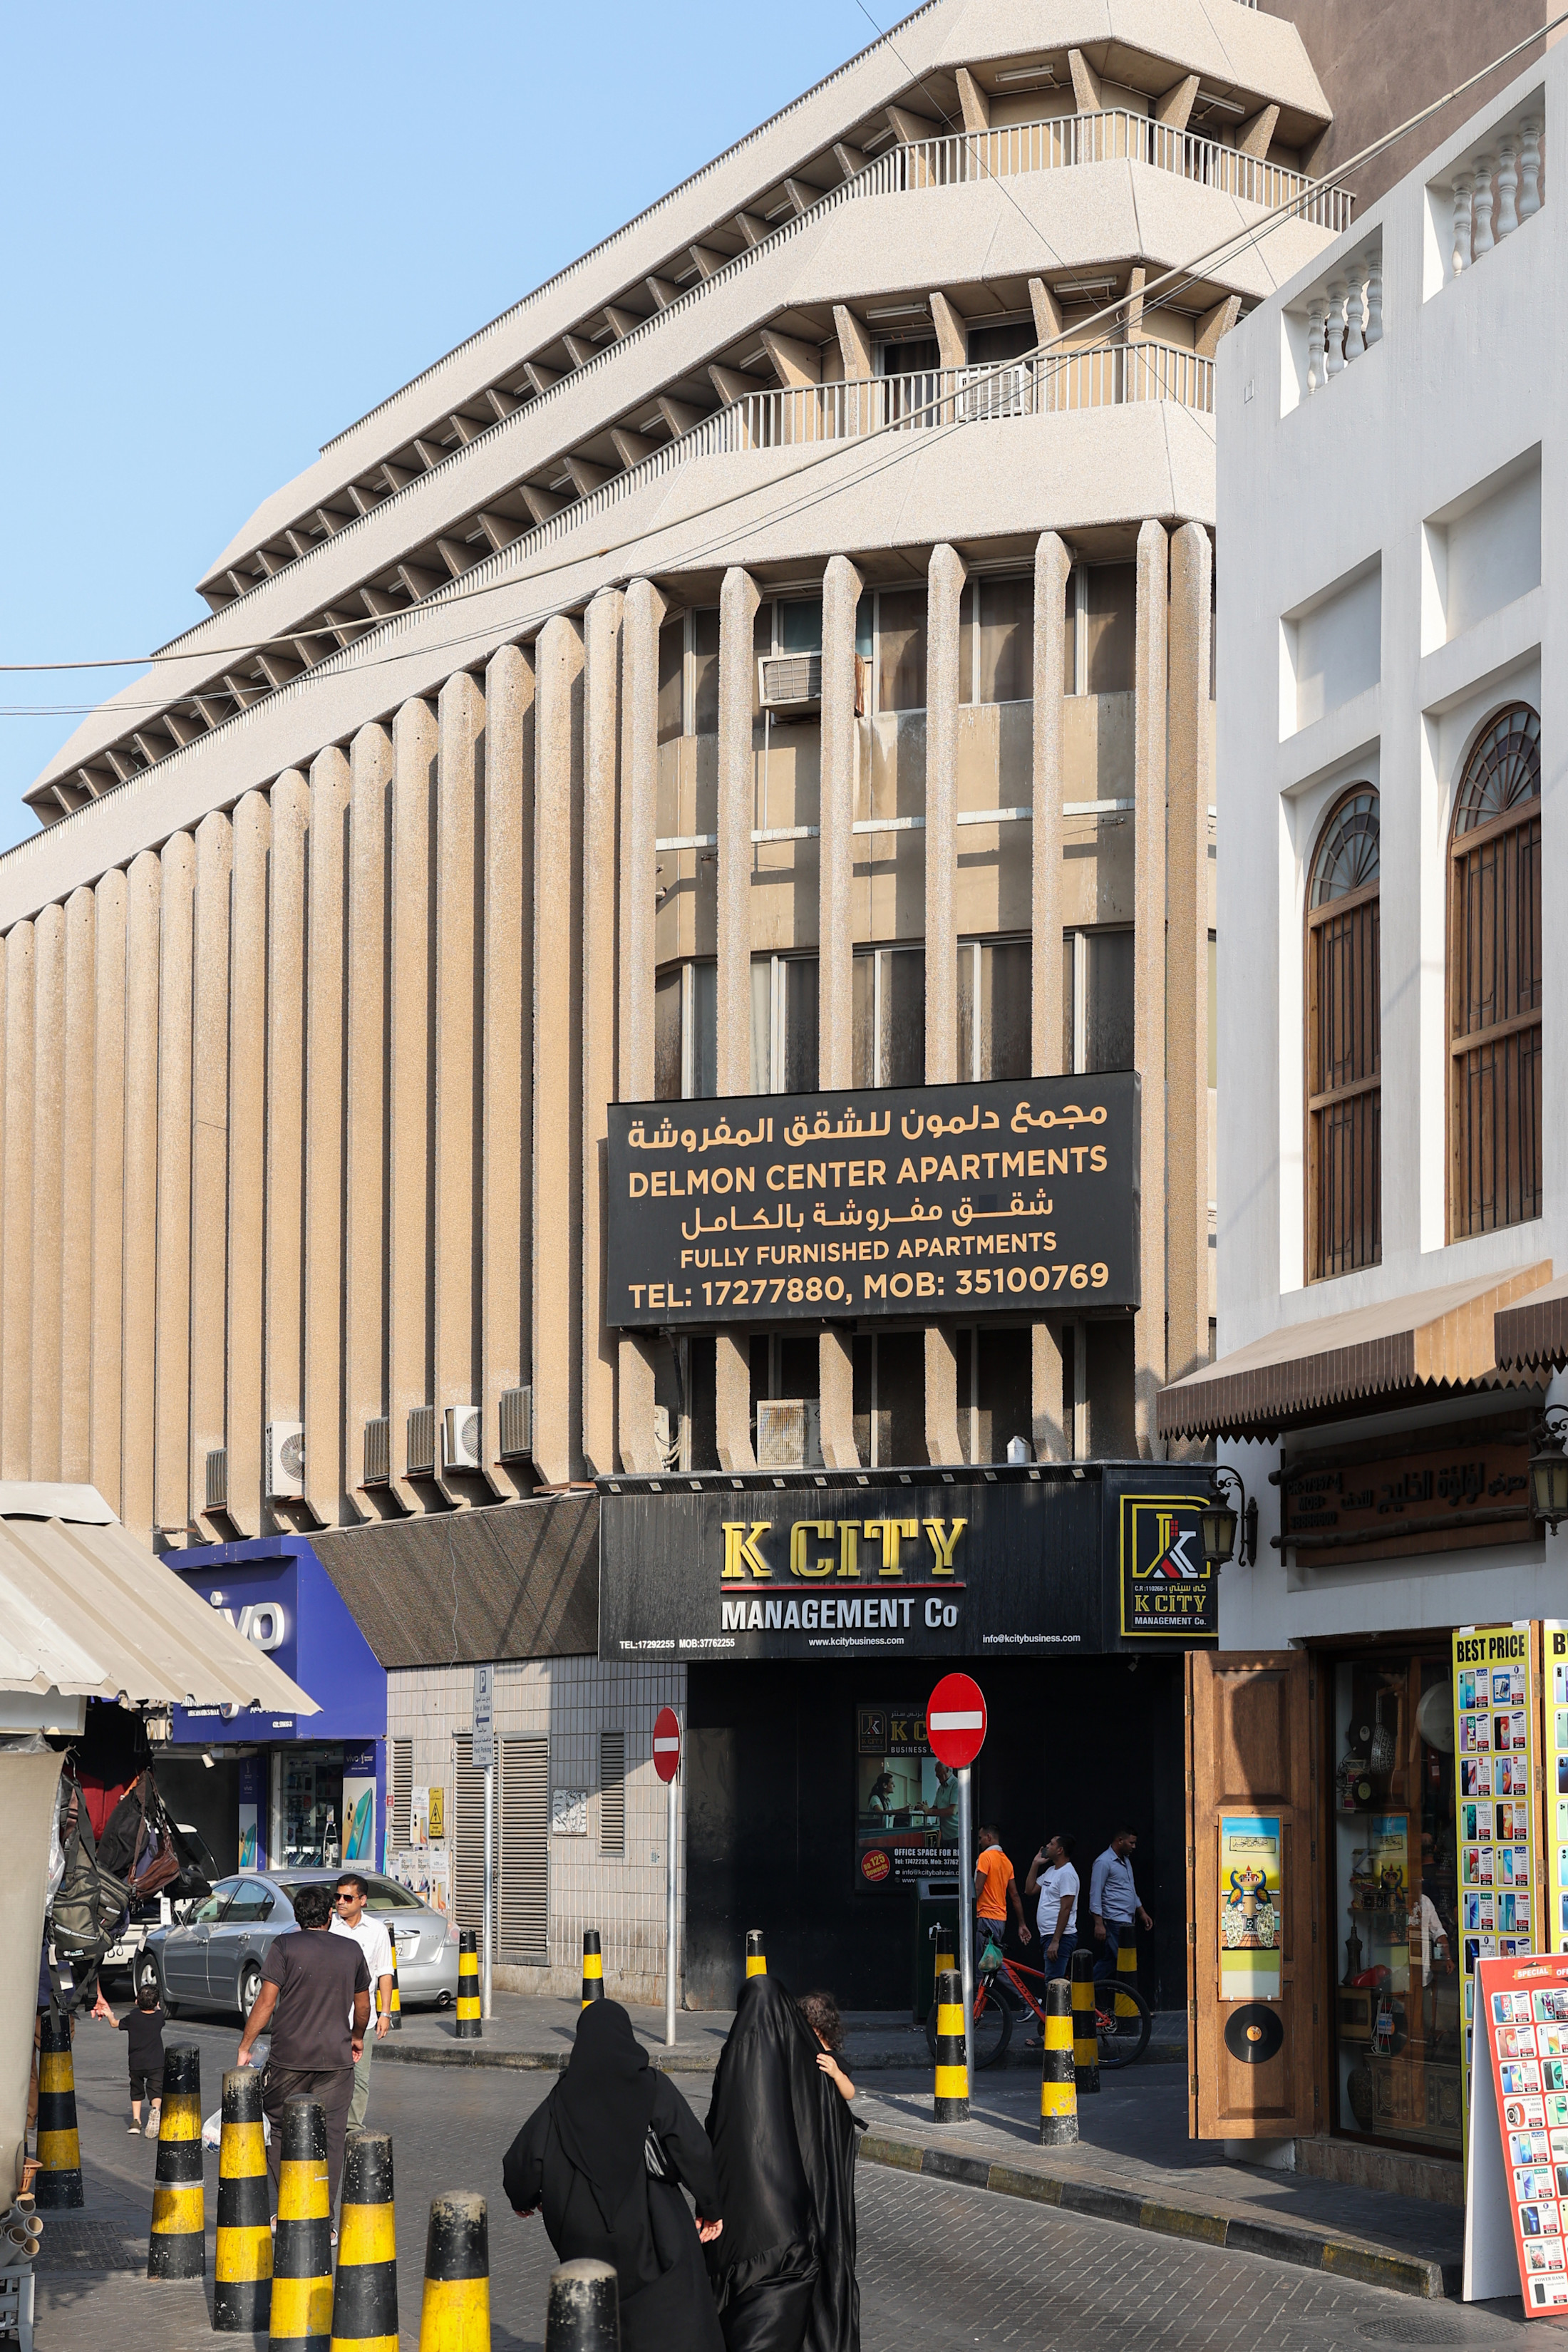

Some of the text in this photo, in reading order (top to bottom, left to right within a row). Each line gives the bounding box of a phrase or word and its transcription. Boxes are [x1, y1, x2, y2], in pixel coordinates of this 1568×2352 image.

[629, 1102, 1108, 1153] مجمع دلمون للشقق المفروشة
[629, 1145, 1108, 1197] DELMON CENTER APARTMENTS
[682, 1203, 804, 1240] بالكامل
[813, 1197, 942, 1232] مفروشة
[681, 1232, 1057, 1269] FULLY FURNISHED APARTMENTS
[629, 1263, 1109, 1309] TEL: 17277880, MOB: 35100769
[721, 1518, 968, 1577] K CITY
[721, 1597, 959, 1630] MANAGEMENT Co
[1135, 1595, 1207, 1612] K CITY
[619, 1639, 735, 1649] TEL:17292255 MOB:37762255
[808, 1636, 904, 1647] www.kcitybusiness.com
[982, 1634, 1081, 1644] info@kcitybusiness.com
[1457, 1634, 1525, 1662] BEST PRICE
[891, 1721, 908, 1741] K
[870, 1853, 886, 1867] 125
[894, 1848, 916, 1857] OFFICE
[1517, 1968, 1549, 1978] SPECIAL
